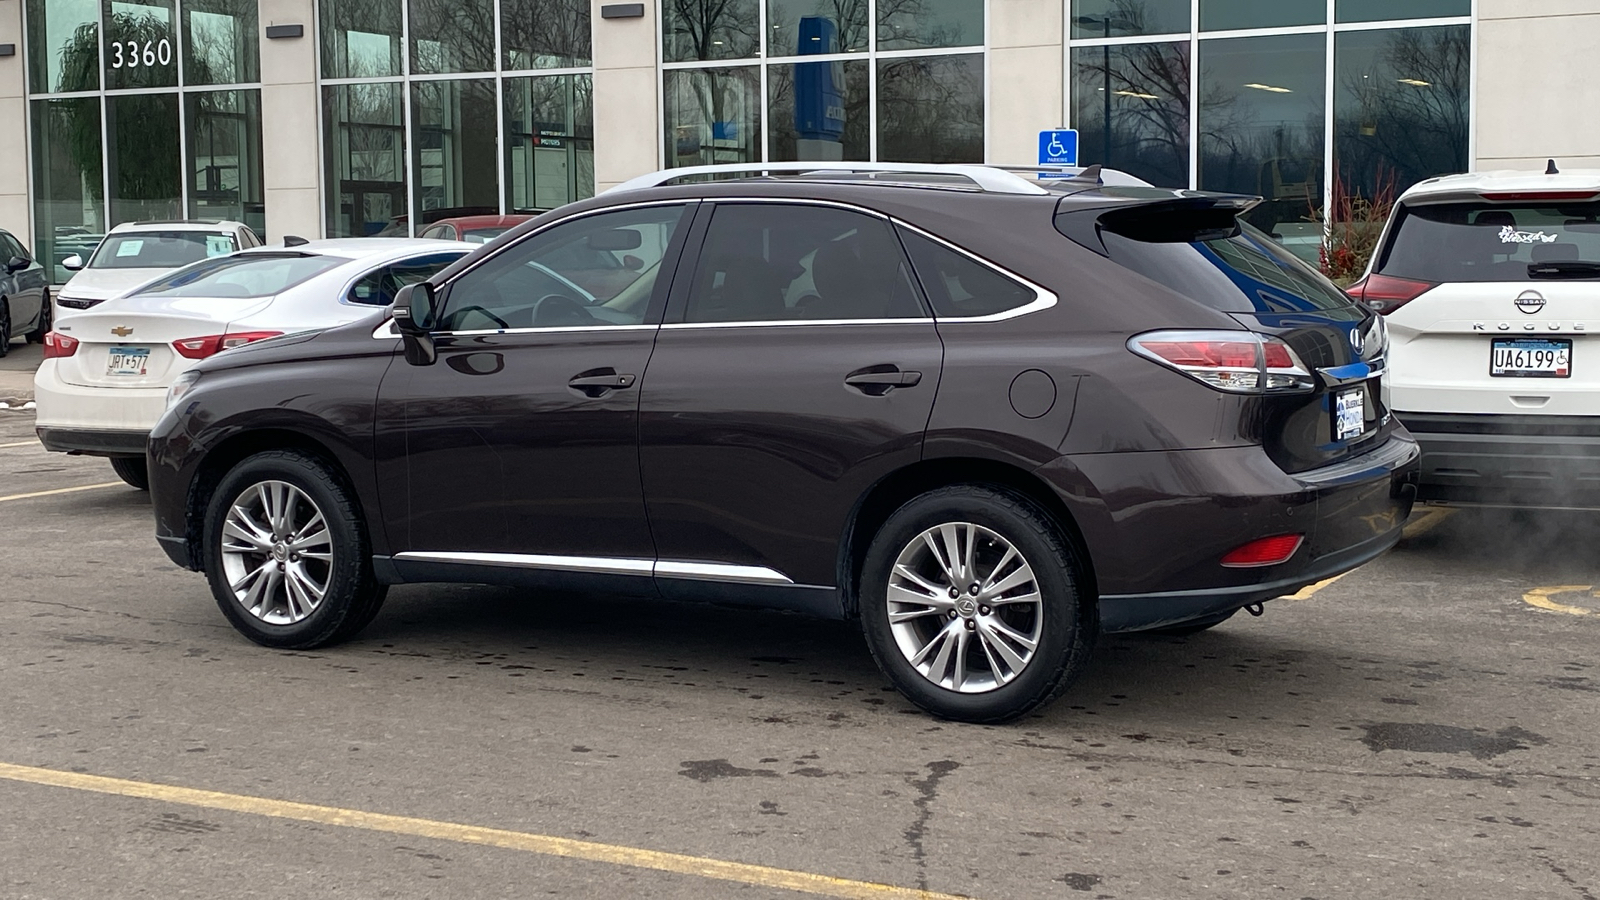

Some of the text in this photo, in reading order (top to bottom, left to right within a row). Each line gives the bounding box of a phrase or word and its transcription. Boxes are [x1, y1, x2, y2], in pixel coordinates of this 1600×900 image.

[111, 38, 171, 68] 3360
[1472, 322, 1585, 331] ROGUE
[1495, 349, 1554, 368] UA6199
[1345, 409, 1364, 427] HONDA
